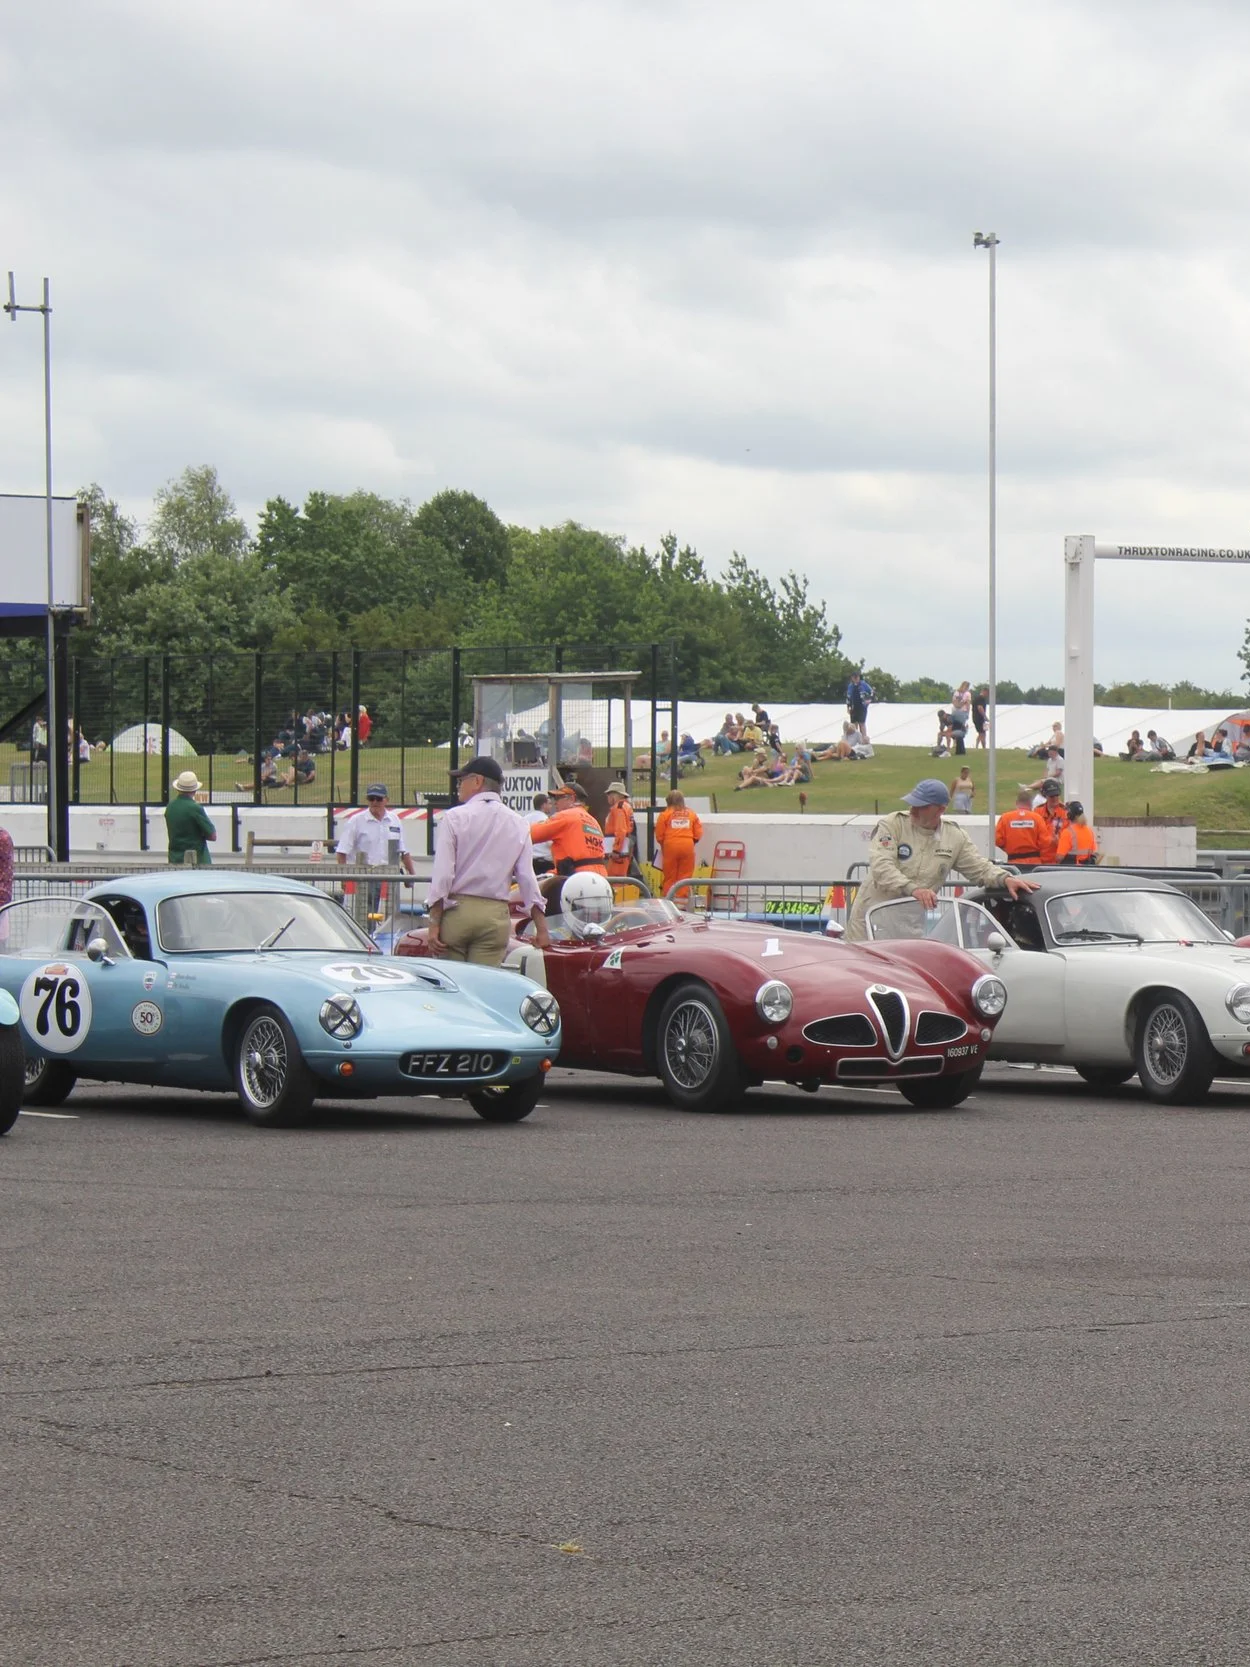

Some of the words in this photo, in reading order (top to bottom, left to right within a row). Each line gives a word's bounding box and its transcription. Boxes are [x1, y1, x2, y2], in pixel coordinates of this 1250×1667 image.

[585, 835, 604, 850] NGK
[761, 938, 784, 957] 1
[333, 965, 404, 981] 76
[34, 977, 81, 1037] 76
[140, 1012, 153, 1024] 50
[408, 1055, 451, 1073] FFZ
[456, 1054, 493, 1072] 210
